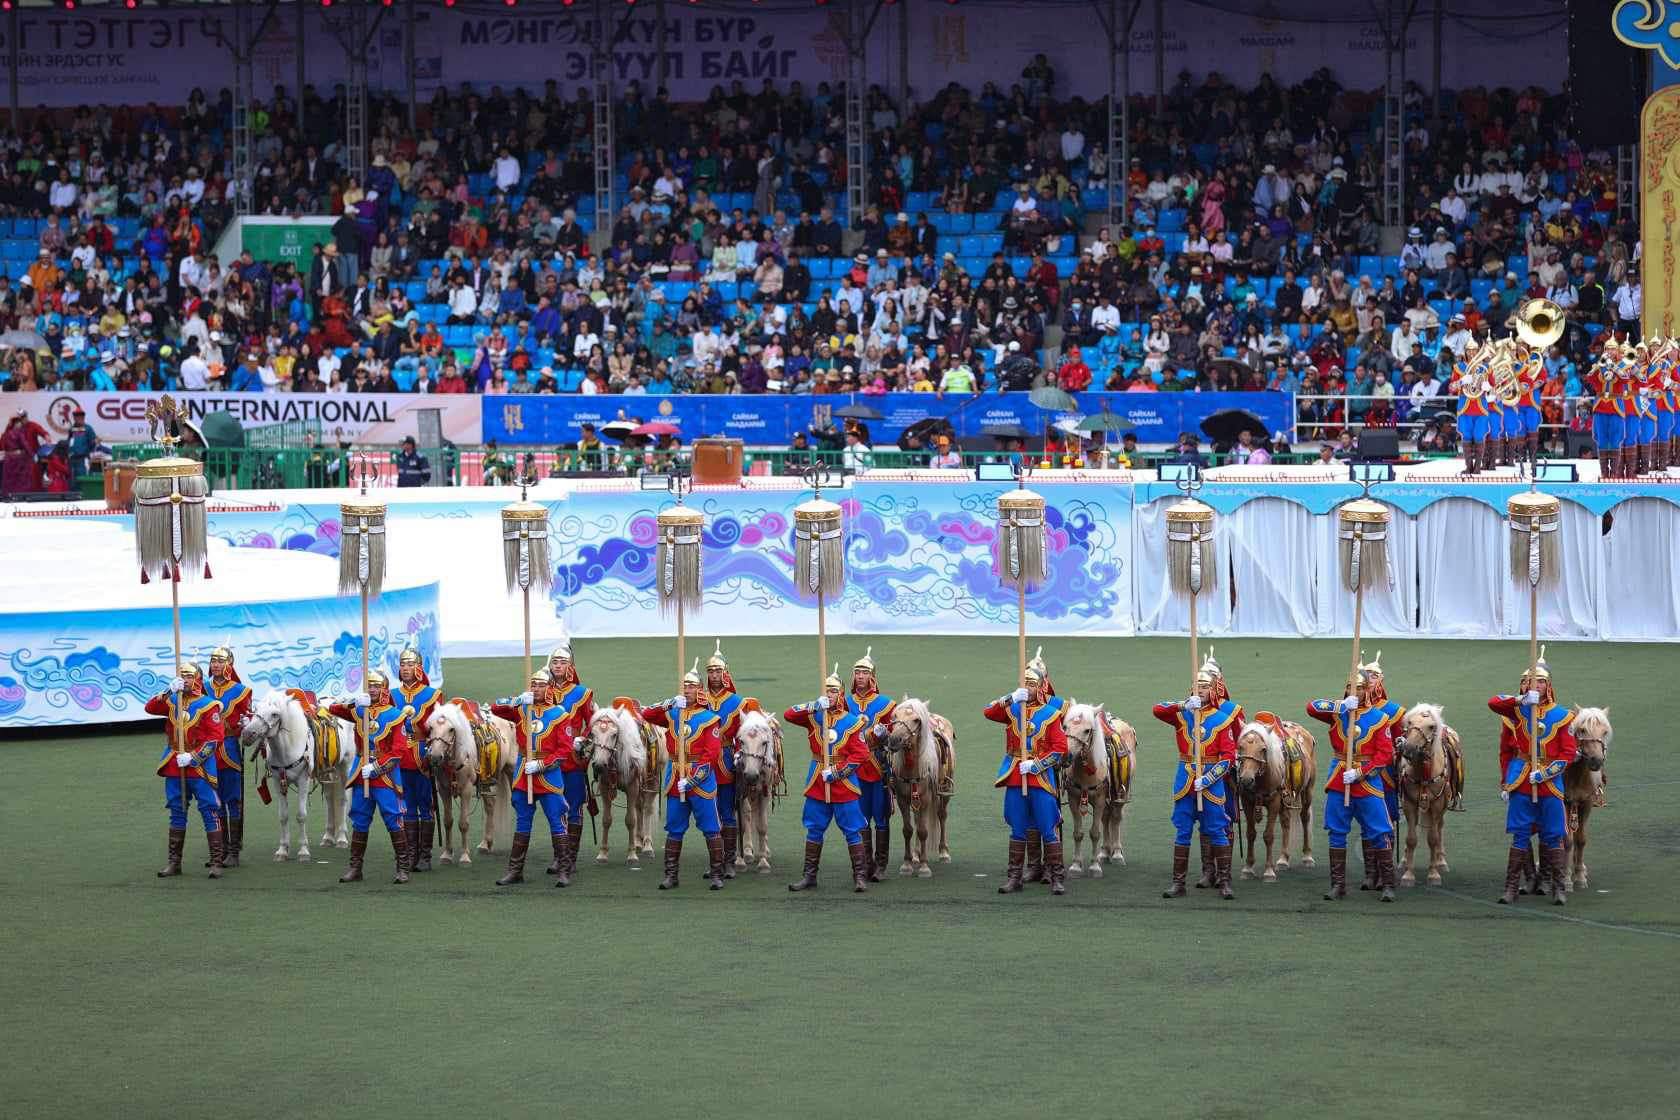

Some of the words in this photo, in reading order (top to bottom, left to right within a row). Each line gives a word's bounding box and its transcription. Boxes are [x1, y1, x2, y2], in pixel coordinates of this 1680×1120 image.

[48, 18, 222, 48] ТЭТГЭГЧ
[695, 18, 756, 42] БҮР
[280, 246, 302, 256] EXIT
